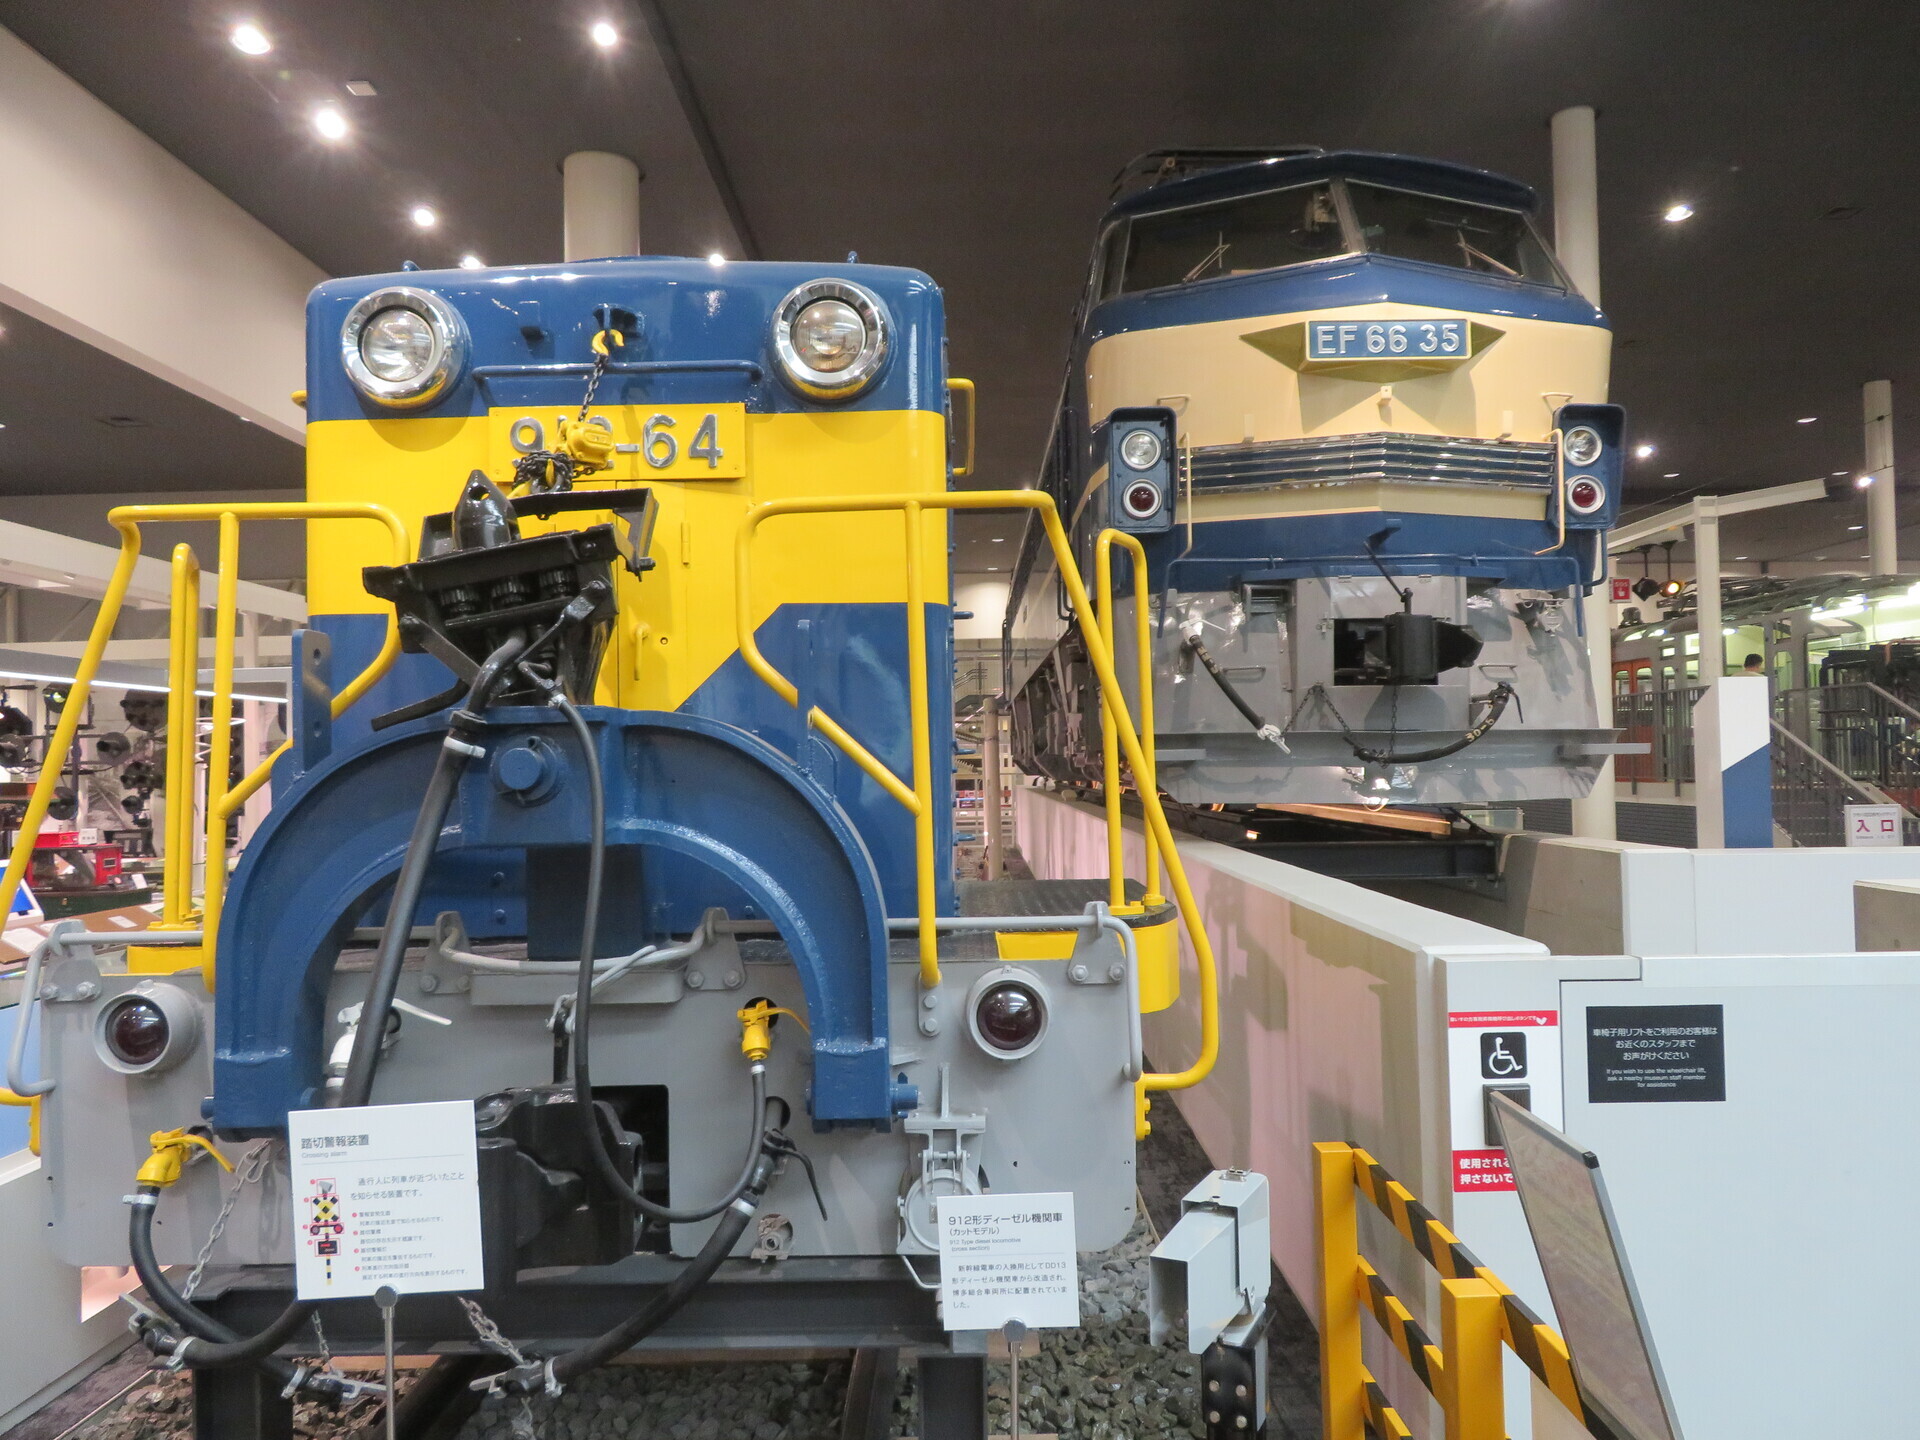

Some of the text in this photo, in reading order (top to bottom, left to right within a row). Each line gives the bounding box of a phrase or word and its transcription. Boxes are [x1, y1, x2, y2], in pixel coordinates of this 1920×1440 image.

[1316, 324, 1460, 354] EF 66 35
[1593, 1027, 1718, 1036] 車椅子用リフトをご利用のお客様は
[1615, 1039, 1696, 1049] お近くのスタッフまで
[1623, 1052, 1690, 1060] お声がけください
[301, 1134, 369, 1149] 踏切警報装置
[358, 1172, 465, 1186] 通行人に列車が近づいたこと
[351, 1189, 423, 1200] を知らせる装置です。
[948, 1213, 1062, 1225] 912形ディーゼル機関車
[958, 1262, 1066, 1272] 新幹線電車の入換用としてDD13
[953, 1287, 1067, 1296] 博多総合車両所に配置されていま
